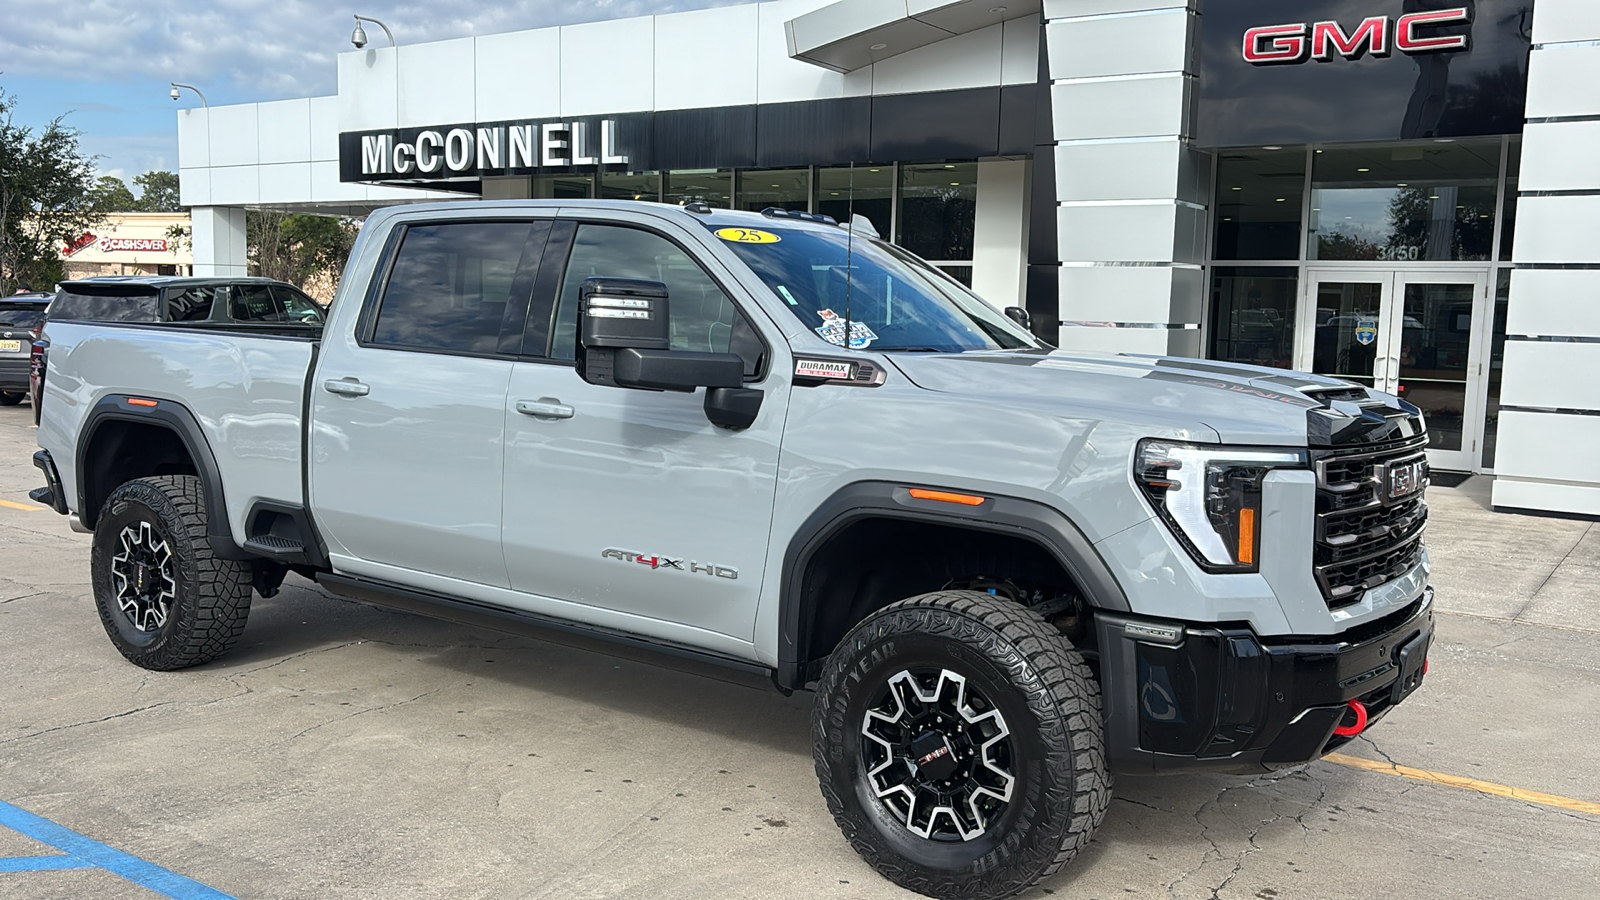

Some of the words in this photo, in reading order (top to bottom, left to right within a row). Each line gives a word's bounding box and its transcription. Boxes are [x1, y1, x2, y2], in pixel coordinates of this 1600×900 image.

[1242, 7, 1470, 64] GMC
[361, 120, 628, 175] McCONNELL
[734, 229, 762, 242] 25
[1376, 245, 1419, 260] 3150
[800, 362, 847, 372] DURAMAX
[601, 546, 686, 570] AT4X
[690, 559, 739, 580] HD
